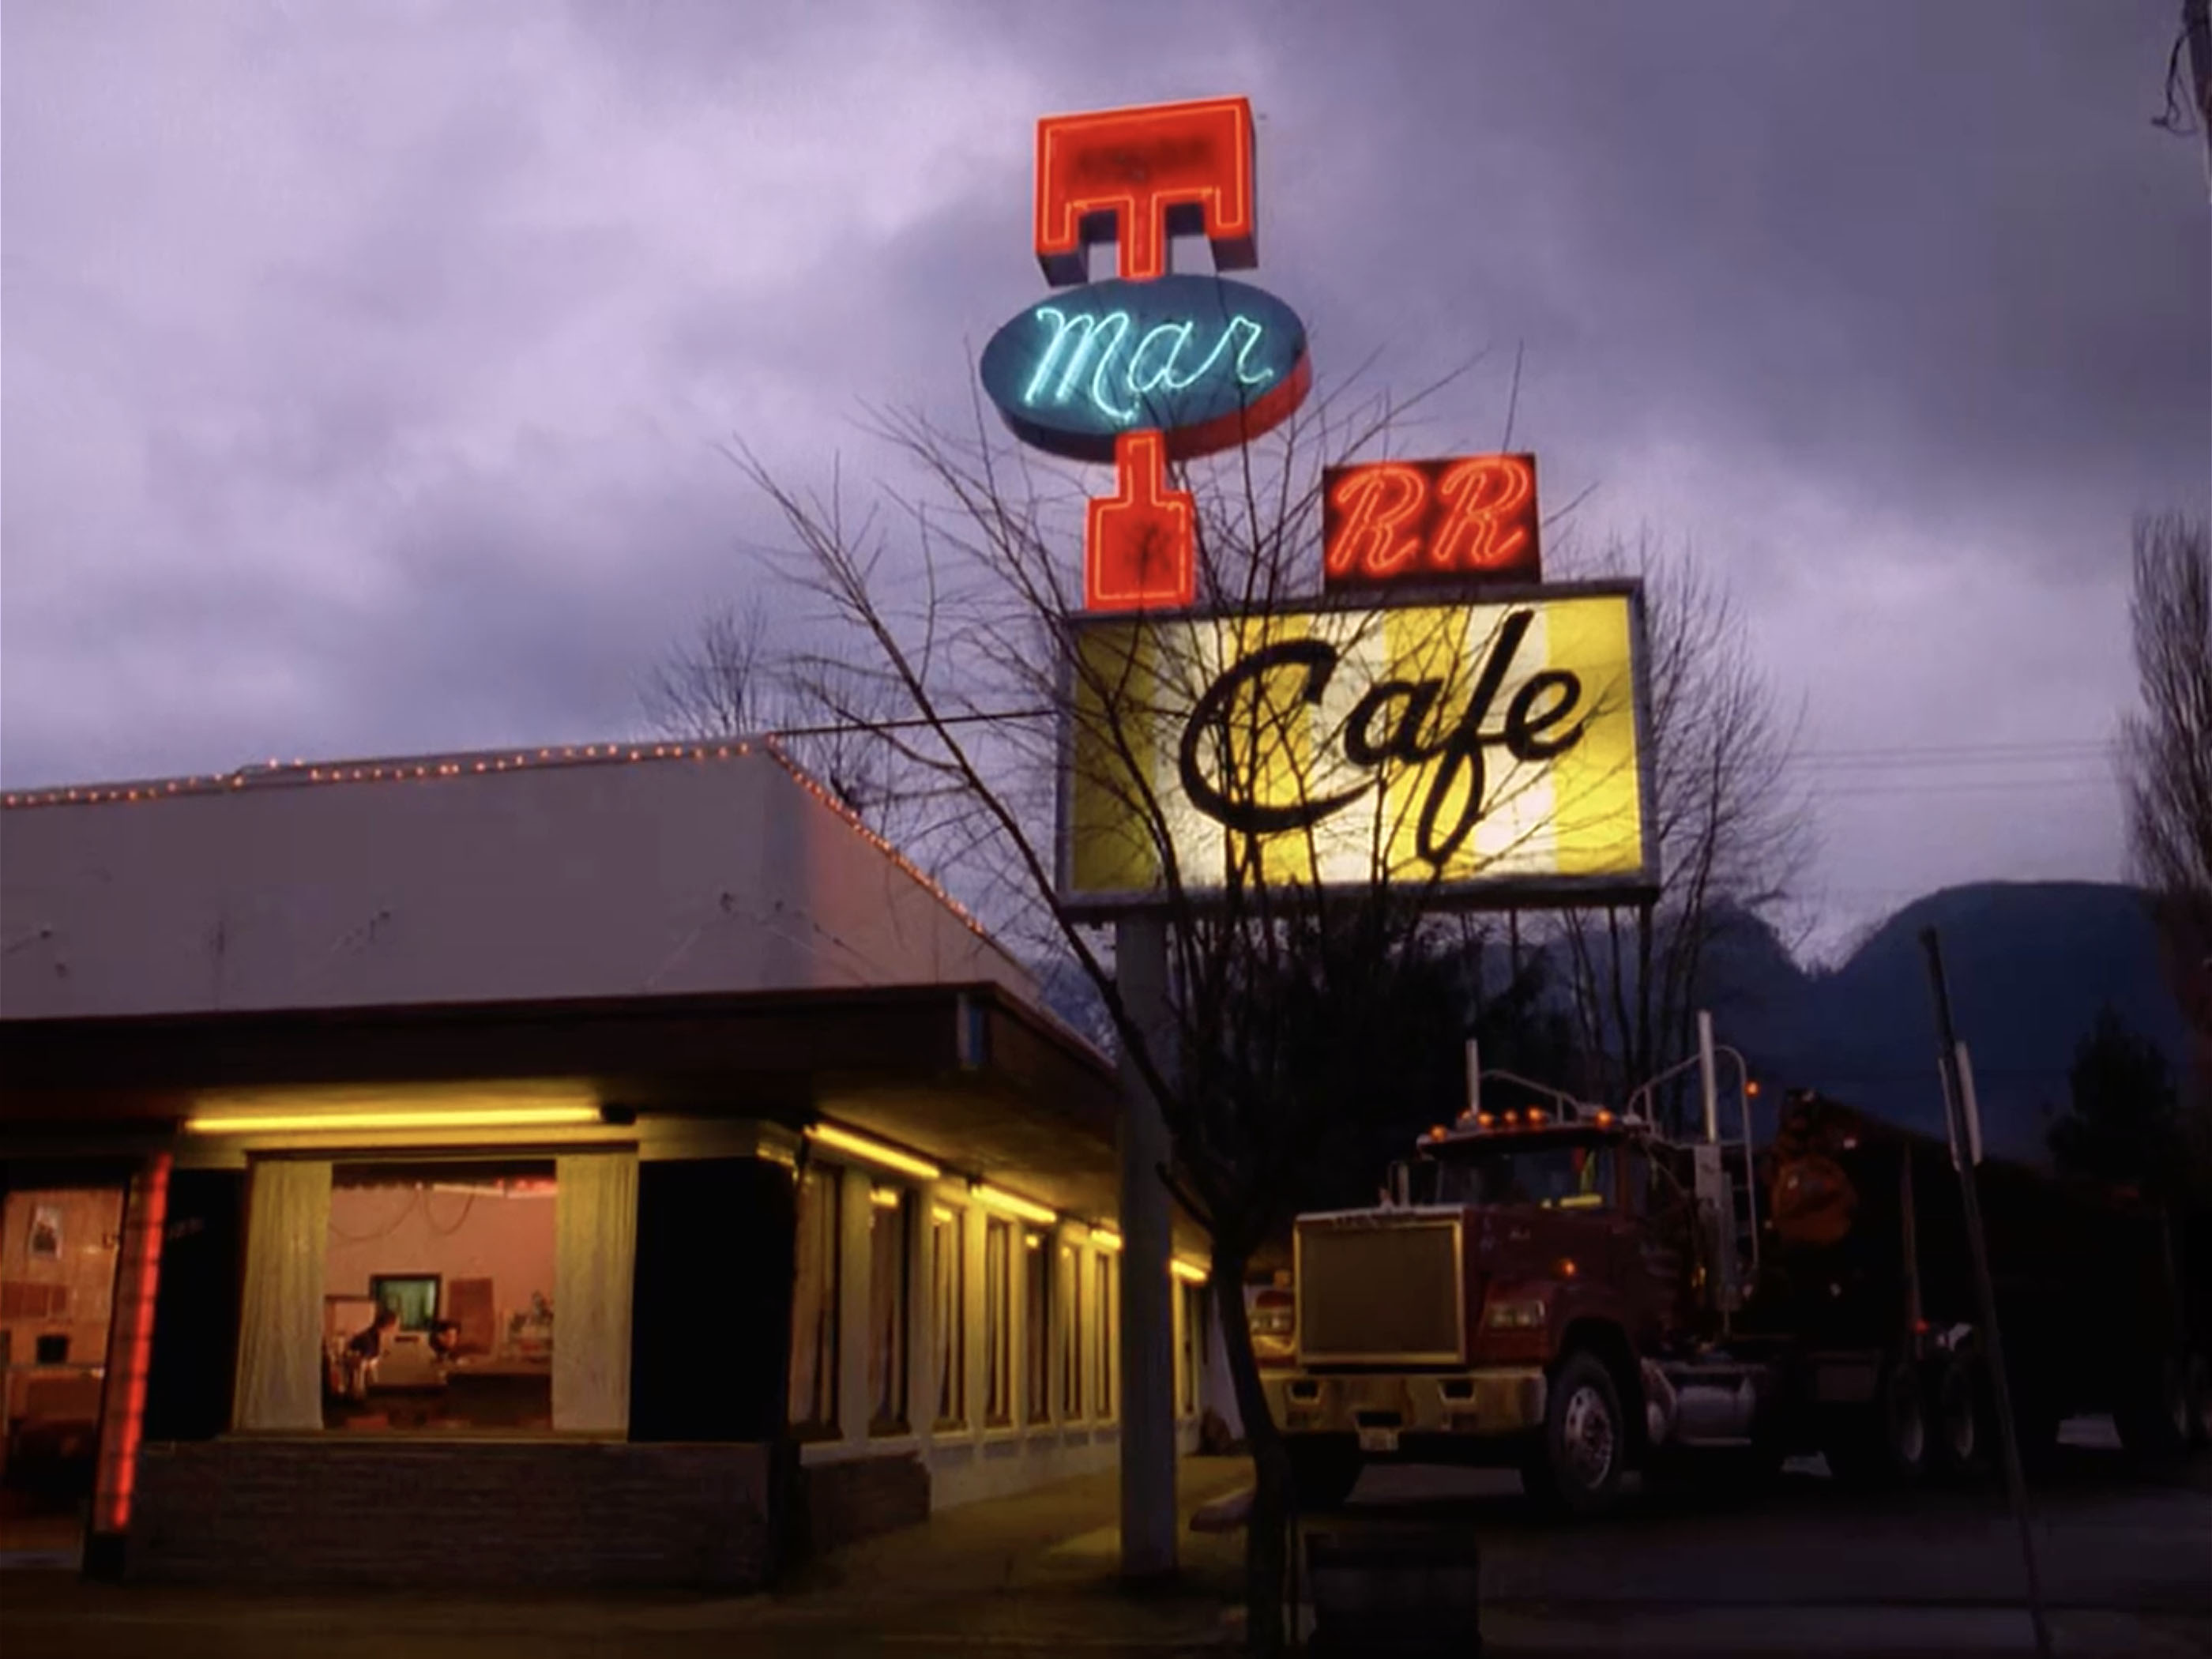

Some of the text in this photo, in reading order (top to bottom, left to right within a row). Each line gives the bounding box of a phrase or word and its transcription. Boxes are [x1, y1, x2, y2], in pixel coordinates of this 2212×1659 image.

[1024, 307, 1273, 423] Mar
[1330, 455, 1531, 574] RR
[1179, 609, 1582, 867] Cafe
